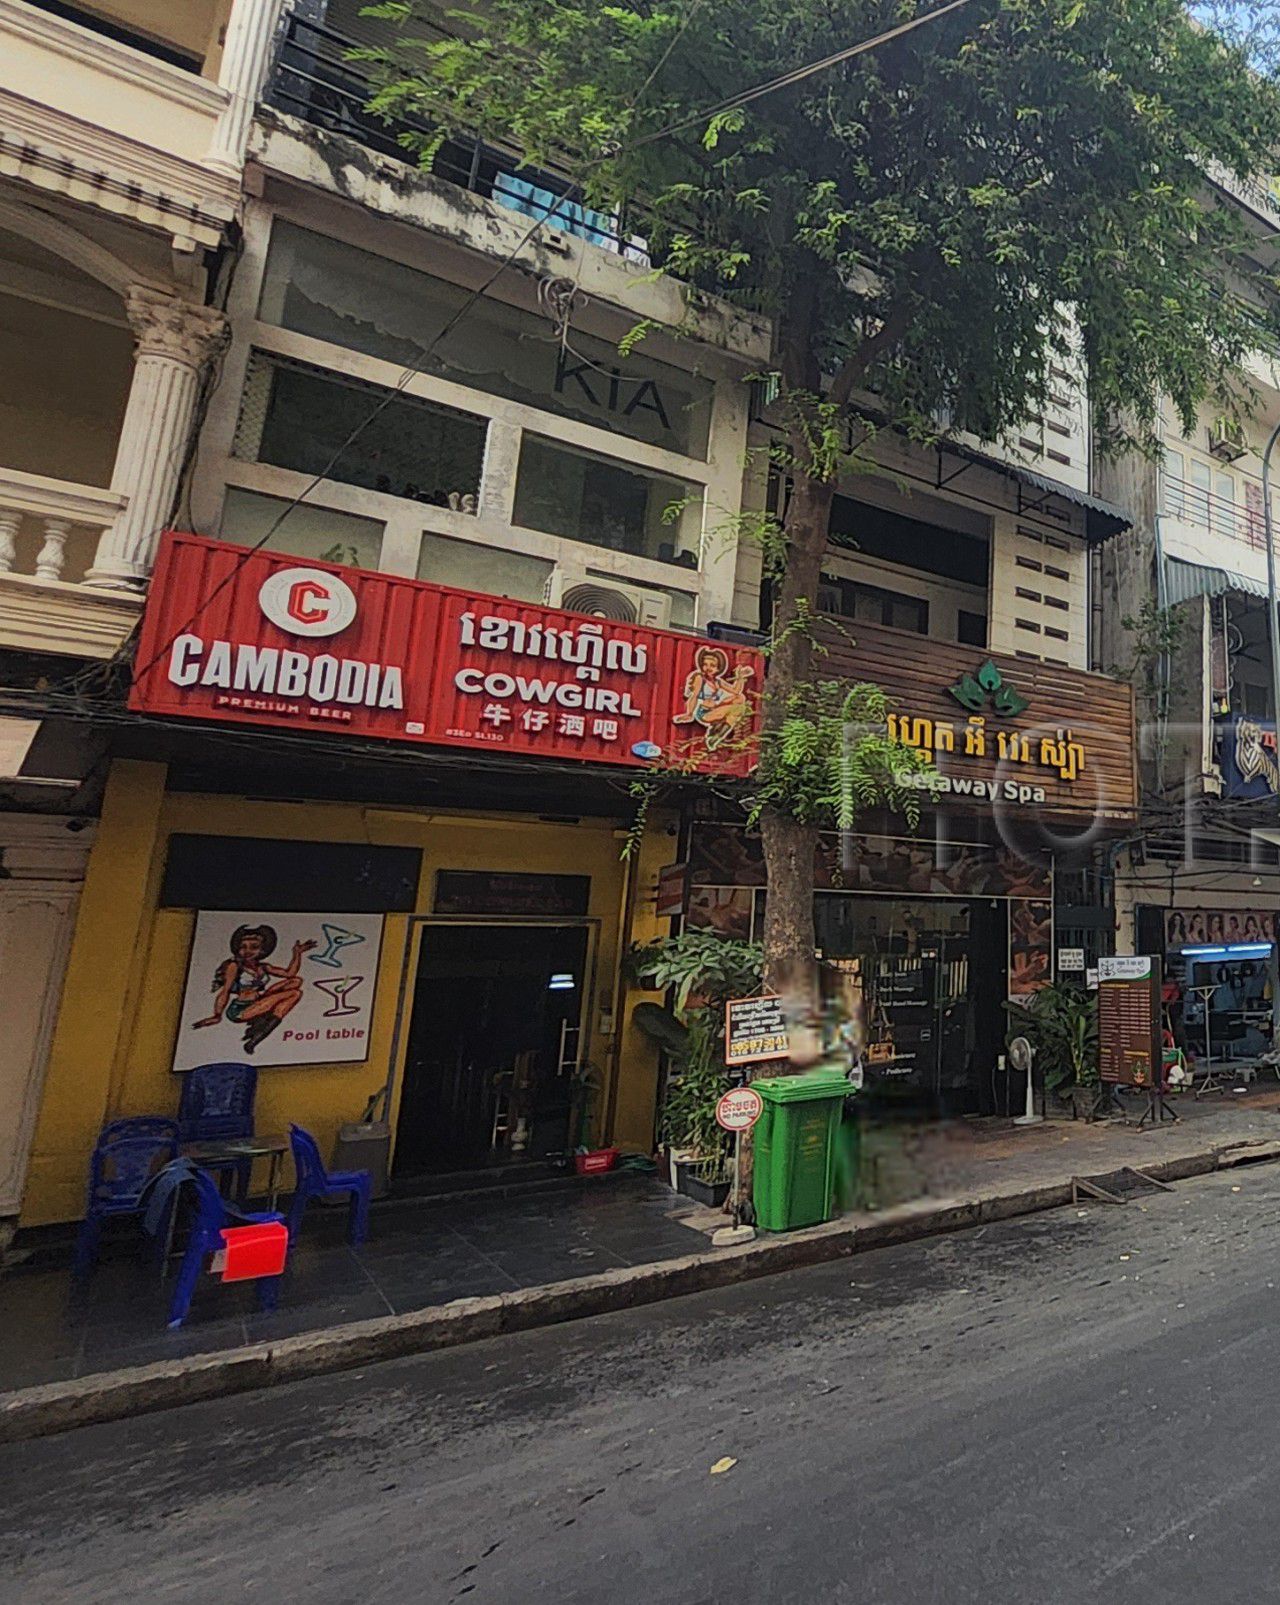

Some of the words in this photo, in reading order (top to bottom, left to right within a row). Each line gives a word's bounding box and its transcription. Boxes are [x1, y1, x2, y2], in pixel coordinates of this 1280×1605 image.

[554, 342, 671, 430] KIA
[168, 634, 404, 710] CAMBODIA
[217, 696, 300, 714] PREMIUM
[309, 707, 352, 721] BEER
[455, 668, 642, 717] COWGIRL
[483, 704, 618, 741] 牛仔酒吧
[1004, 779, 1046, 805] Spa
[282, 1029, 320, 1041] Pool
[326, 1027, 365, 1040] table
